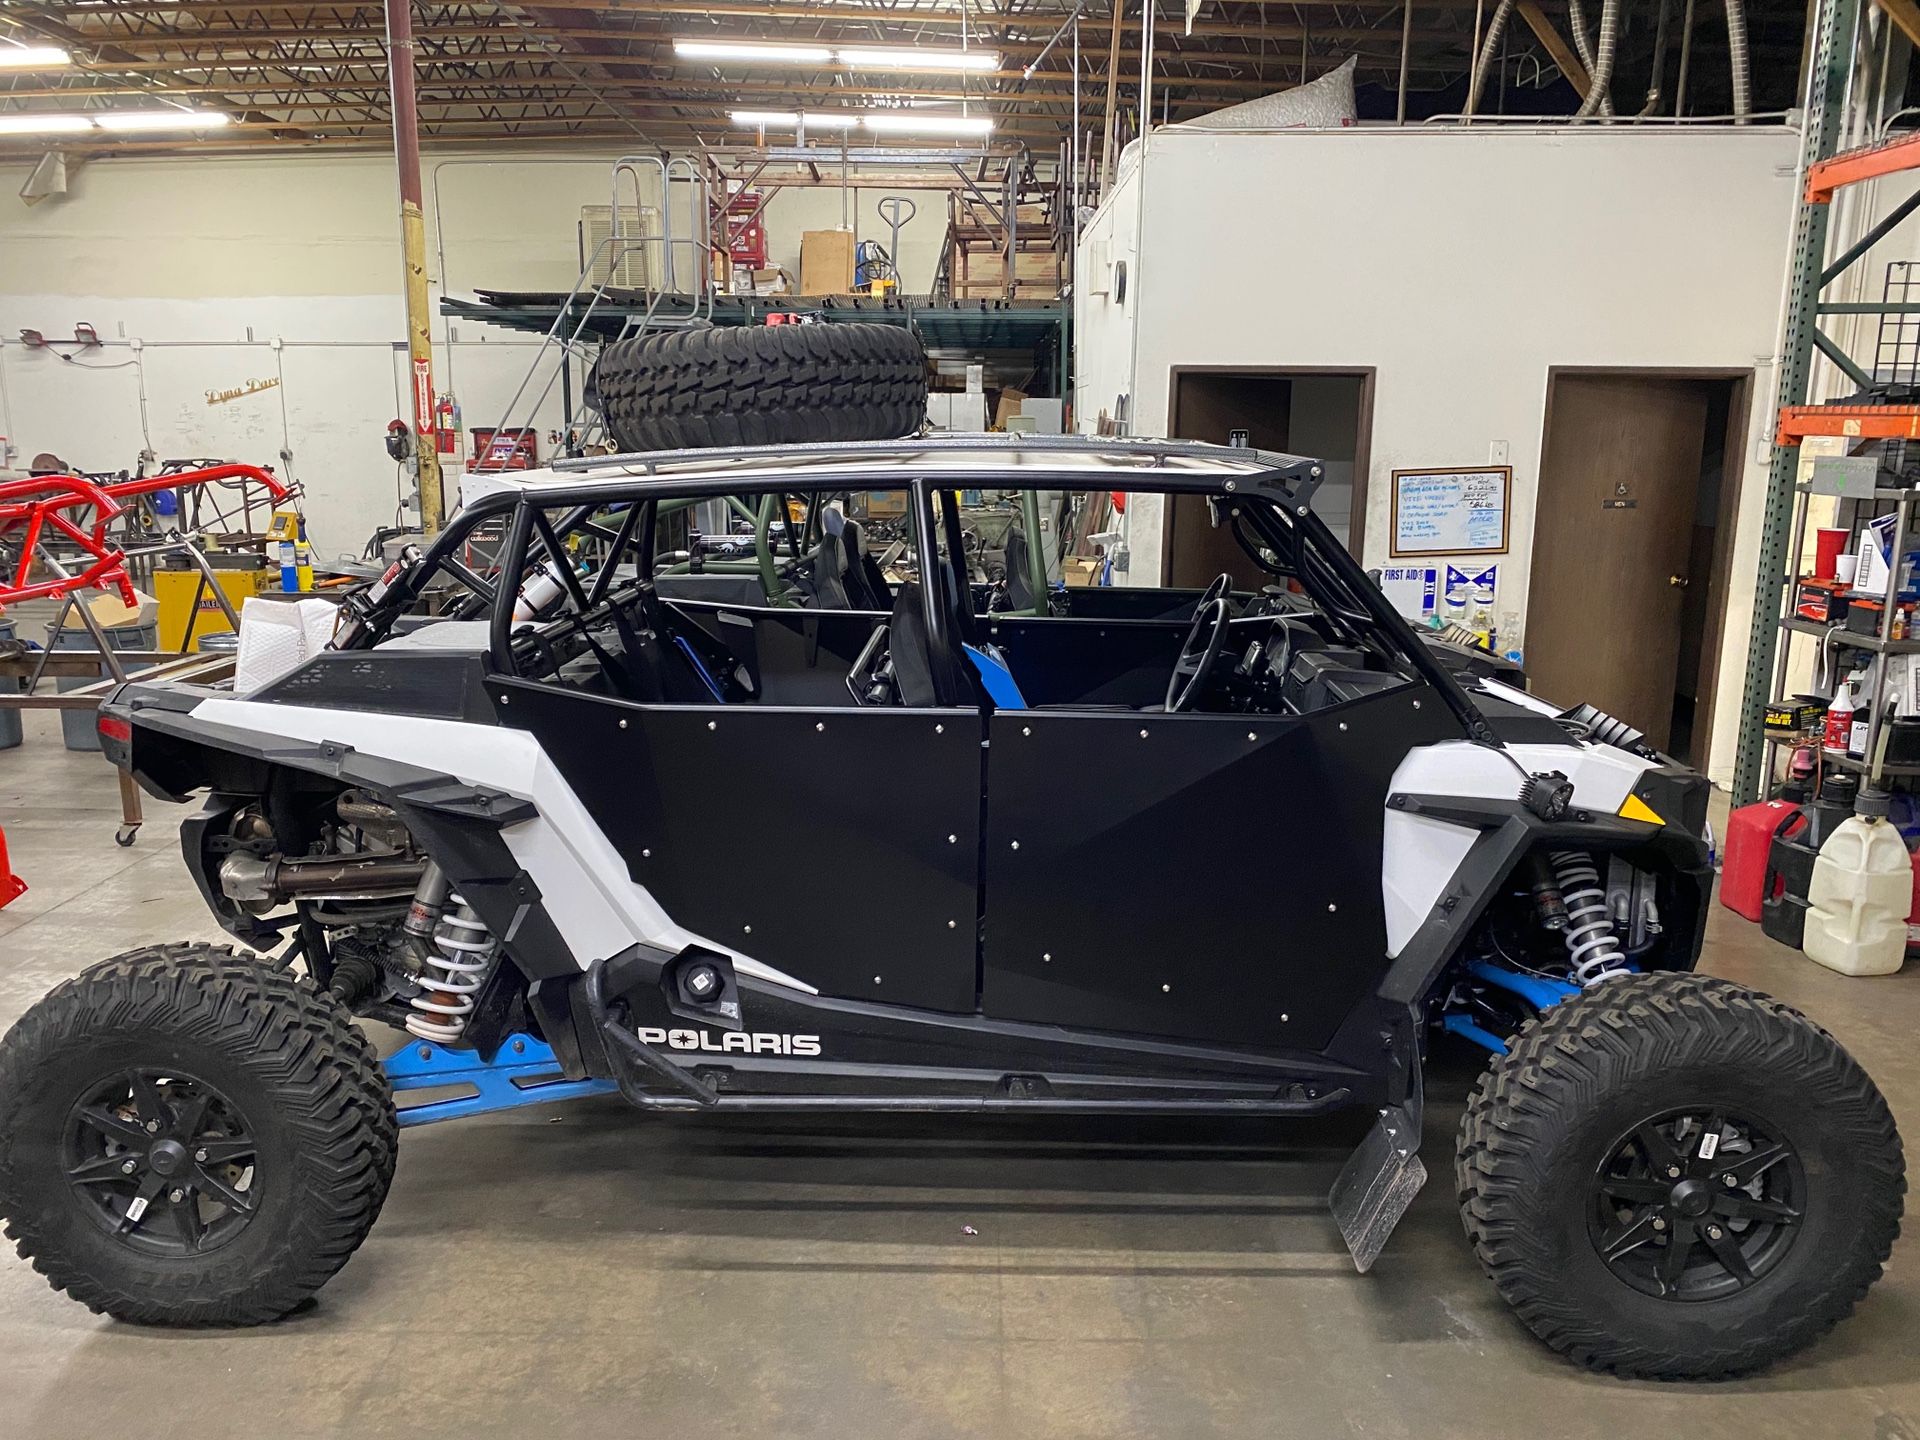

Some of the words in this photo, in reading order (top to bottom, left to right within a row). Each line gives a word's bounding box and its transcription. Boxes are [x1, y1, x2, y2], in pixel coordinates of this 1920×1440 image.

[416, 365, 428, 373] FIRE
[1384, 569, 1403, 580] FIRST
[1405, 569, 1417, 580] AID
[1424, 581, 1435, 596] XXL
[637, 1026, 821, 1056] POLARIS
